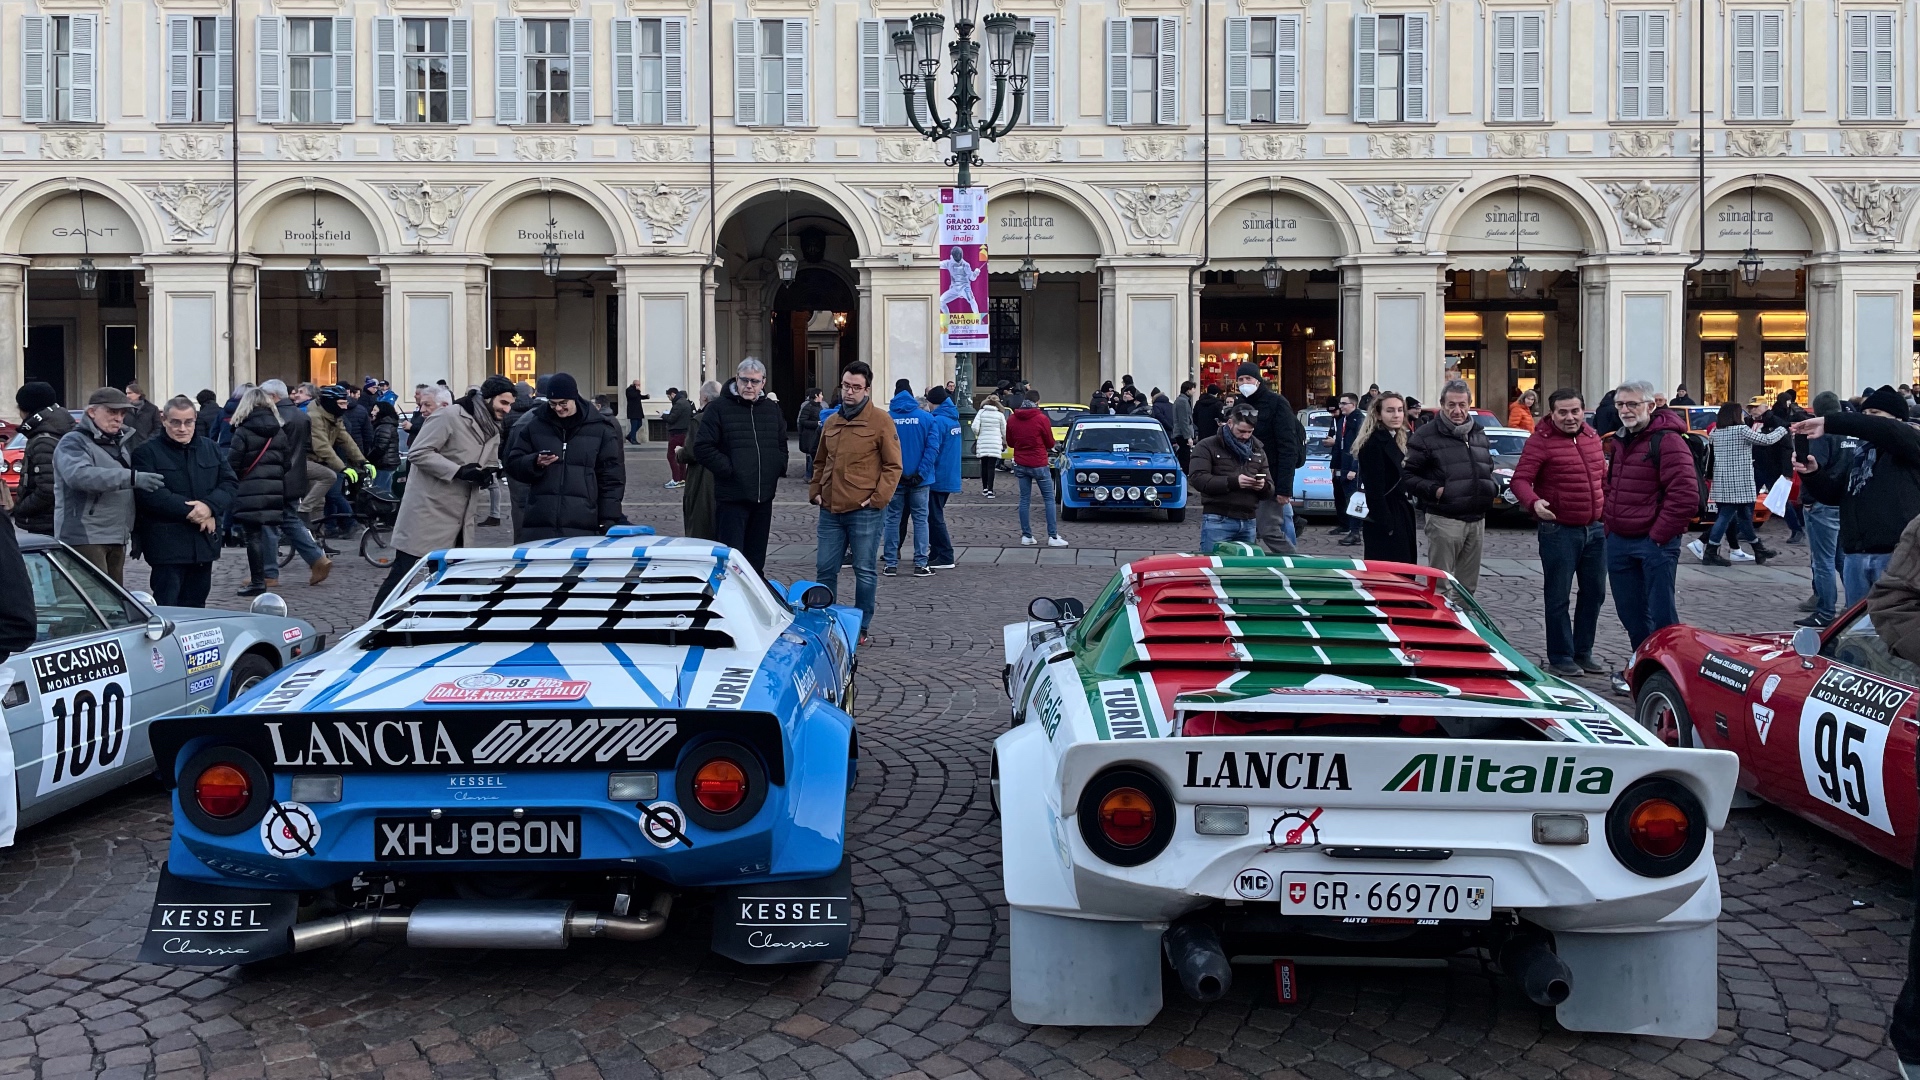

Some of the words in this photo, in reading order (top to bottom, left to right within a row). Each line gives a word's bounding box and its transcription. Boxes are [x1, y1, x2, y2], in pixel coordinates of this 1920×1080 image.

[1000, 209, 1054, 227] sinatra
[1242, 211, 1297, 230] sinatra
[1484, 204, 1540, 223] sinatra
[1718, 204, 1774, 222] sinatra
[52, 227, 120, 237] GANT
[284, 230, 351, 240] Brooksfield
[518, 229, 585, 240] Brooksfield
[952, 235, 974, 243] inalpi
[1201, 322, 1301, 333] TRATTA
[35, 655, 55, 679] LE
[56, 641, 120, 670] CASINO
[196, 648, 219, 666] BPS
[190, 676, 214, 691] sparco
[431, 686, 481, 698] RALLYE
[481, 683, 586, 698] MONTE-CARLO
[506, 678, 531, 688] 98
[537, 678, 563, 688] 2023
[1821, 668, 1841, 688] LE
[1836, 673, 1902, 708] CASINO
[1032, 675, 1063, 744] Alitalia
[1103, 687, 1147, 739] TURIN
[52, 682, 125, 784] 100
[264, 719, 463, 767] LANCIA
[1182, 751, 1352, 791] LANCIA
[1381, 753, 1614, 795] Alitalia
[1815, 711, 1869, 817] 95
[450, 776, 503, 786] KESSEL
[454, 791, 500, 801] Classic
[381, 822, 459, 857] XHJ
[471, 820, 575, 854] 860N
[1241, 875, 1268, 891] MC
[161, 909, 262, 927] KESSEL
[741, 902, 839, 920] KESSEL
[163, 937, 250, 957] Classic
[748, 931, 830, 950] Classic
[1282, 965, 1291, 999] sparco
